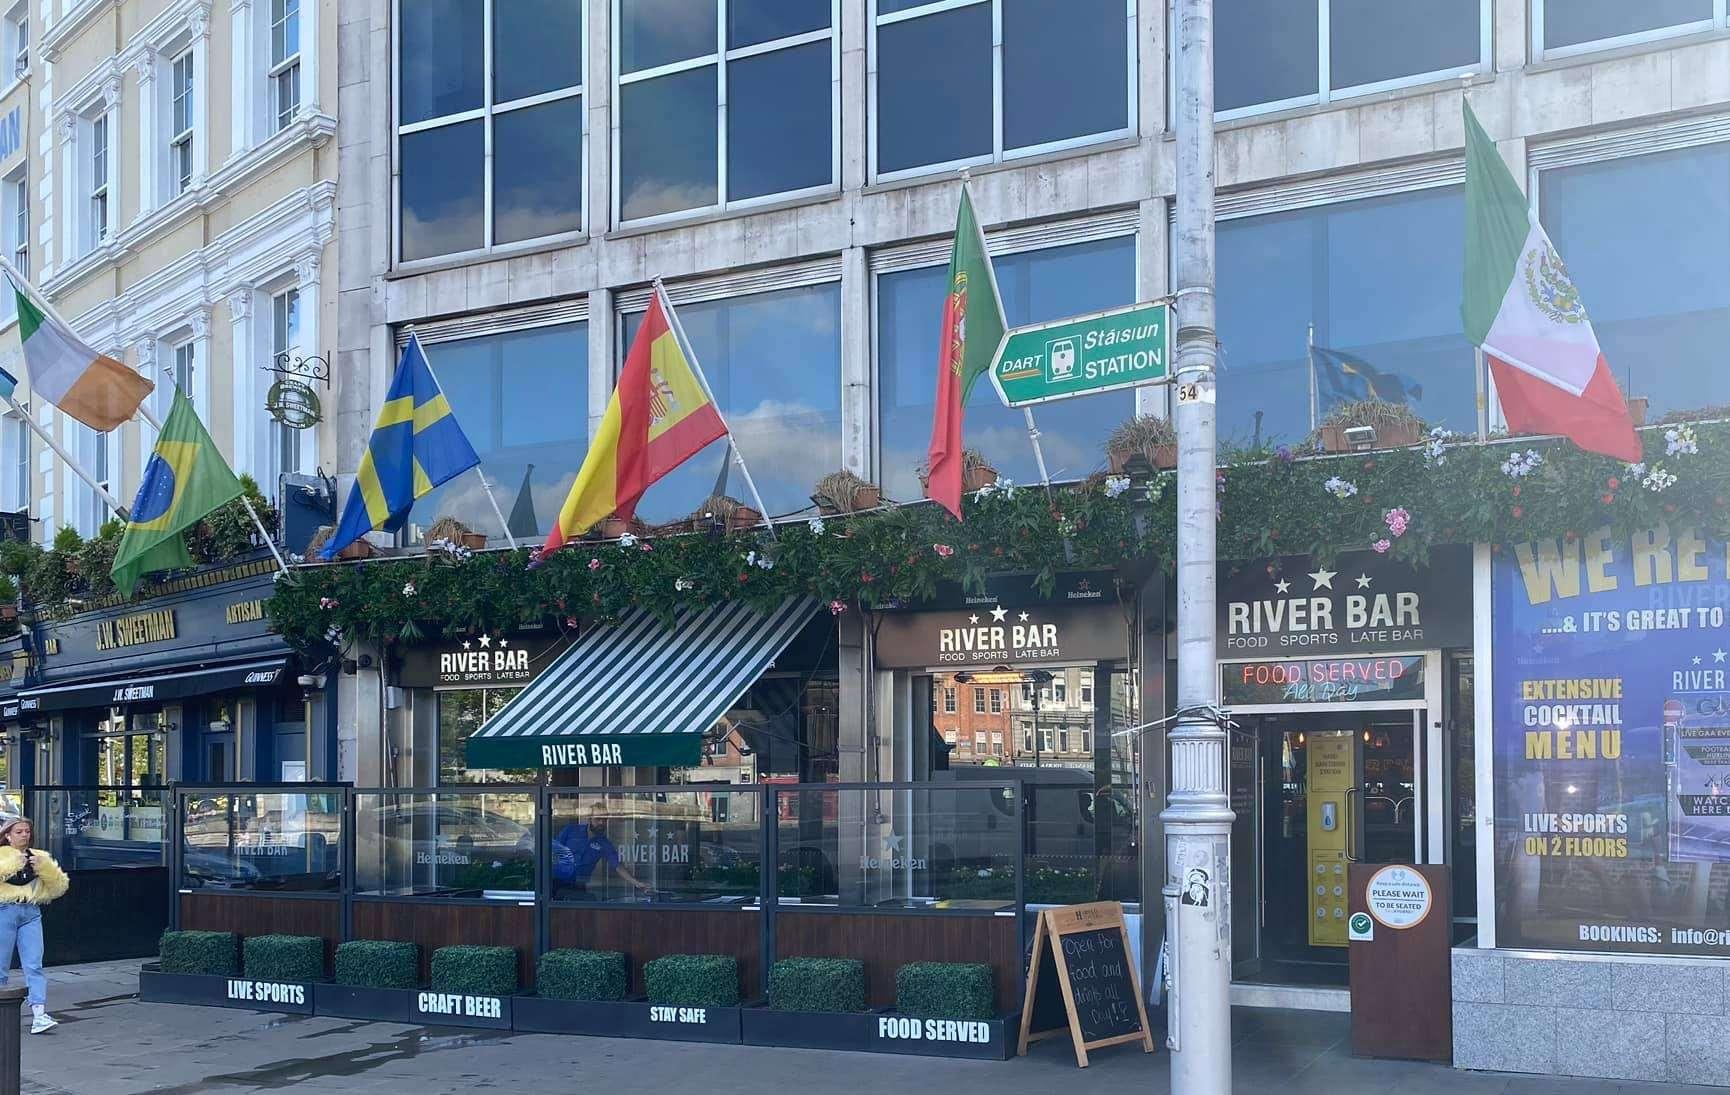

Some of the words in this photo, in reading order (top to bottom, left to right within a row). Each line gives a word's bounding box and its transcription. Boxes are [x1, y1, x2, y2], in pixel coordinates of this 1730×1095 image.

[1002, 355, 1043, 372] DART
[1085, 349, 1162, 379] STATION
[1179, 384, 1197, 400] 54
[226, 600, 262, 624] ARTISAN
[1229, 597, 1333, 634] RIVER
[1347, 592, 1420, 628] BAR
[1583, 611, 1620, 632] IT'S
[1627, 608, 1691, 630] GREAT
[1697, 606, 1723, 628] TO
[117, 609, 176, 647] SWEETMAN
[940, 627, 1005, 652] RIVER
[1012, 624, 1058, 649] BAR
[1227, 636, 1268, 648] FOOD
[1280, 633, 1338, 646] SPORTS
[1351, 631, 1387, 643] LATE
[1392, 629, 1424, 640] BAR
[440, 651, 489, 673] RIVER
[494, 649, 529, 671] BAR
[939, 652, 966, 661] FOOD
[972, 650, 1008, 660] SPORTS
[1015, 650, 1038, 659] LATE
[1040, 648, 1060, 658] BAR
[464, 672, 492, 681] SPORTS
[1242, 665, 1301, 684] FOOD
[1313, 660, 1404, 682] SERVED
[1672, 670, 1726, 690] RIVER
[124, 686, 154, 700] SWEETMAN
[1522, 678, 1623, 700] EXTENSIVE
[1523, 703, 1623, 727] COCKTAIL
[542, 744, 588, 765] RIVER
[591, 743, 622, 764] BAR
[1525, 730, 1621, 760] MENU
[1693, 806, 1722, 814] HERE
[1525, 813, 1557, 833] LIVE
[1561, 814, 1628, 834] SPORTS
[416, 851, 469, 864] Heineken
[618, 844, 656, 863] RIVER
[662, 844, 689, 863] BAR
[1526, 837, 1548, 856] ON
[1551, 836, 1562, 856] 2
[1565, 838, 1628, 858] FLOORS
[859, 855, 927, 869] Heineken
[1372, 889, 1401, 898] PLEASE
[1402, 890, 1425, 899] WAIT
[1395, 902, 1422, 910] SEATED
[1579, 924, 1662, 943] BOOKINGS:
[1065, 938, 1095, 959] Open
[1102, 960, 1122, 978] and
[227, 980, 253, 1000] LIVE
[255, 982, 305, 1004] SPORTS
[418, 992, 463, 1015] CRAFT
[465, 996, 501, 1018] BEER
[650, 1006, 677, 1022] STAY
[679, 1007, 706, 1024] SAFE
[878, 1017, 922, 1040] FOOD
[925, 1019, 990, 1043] SERVED
